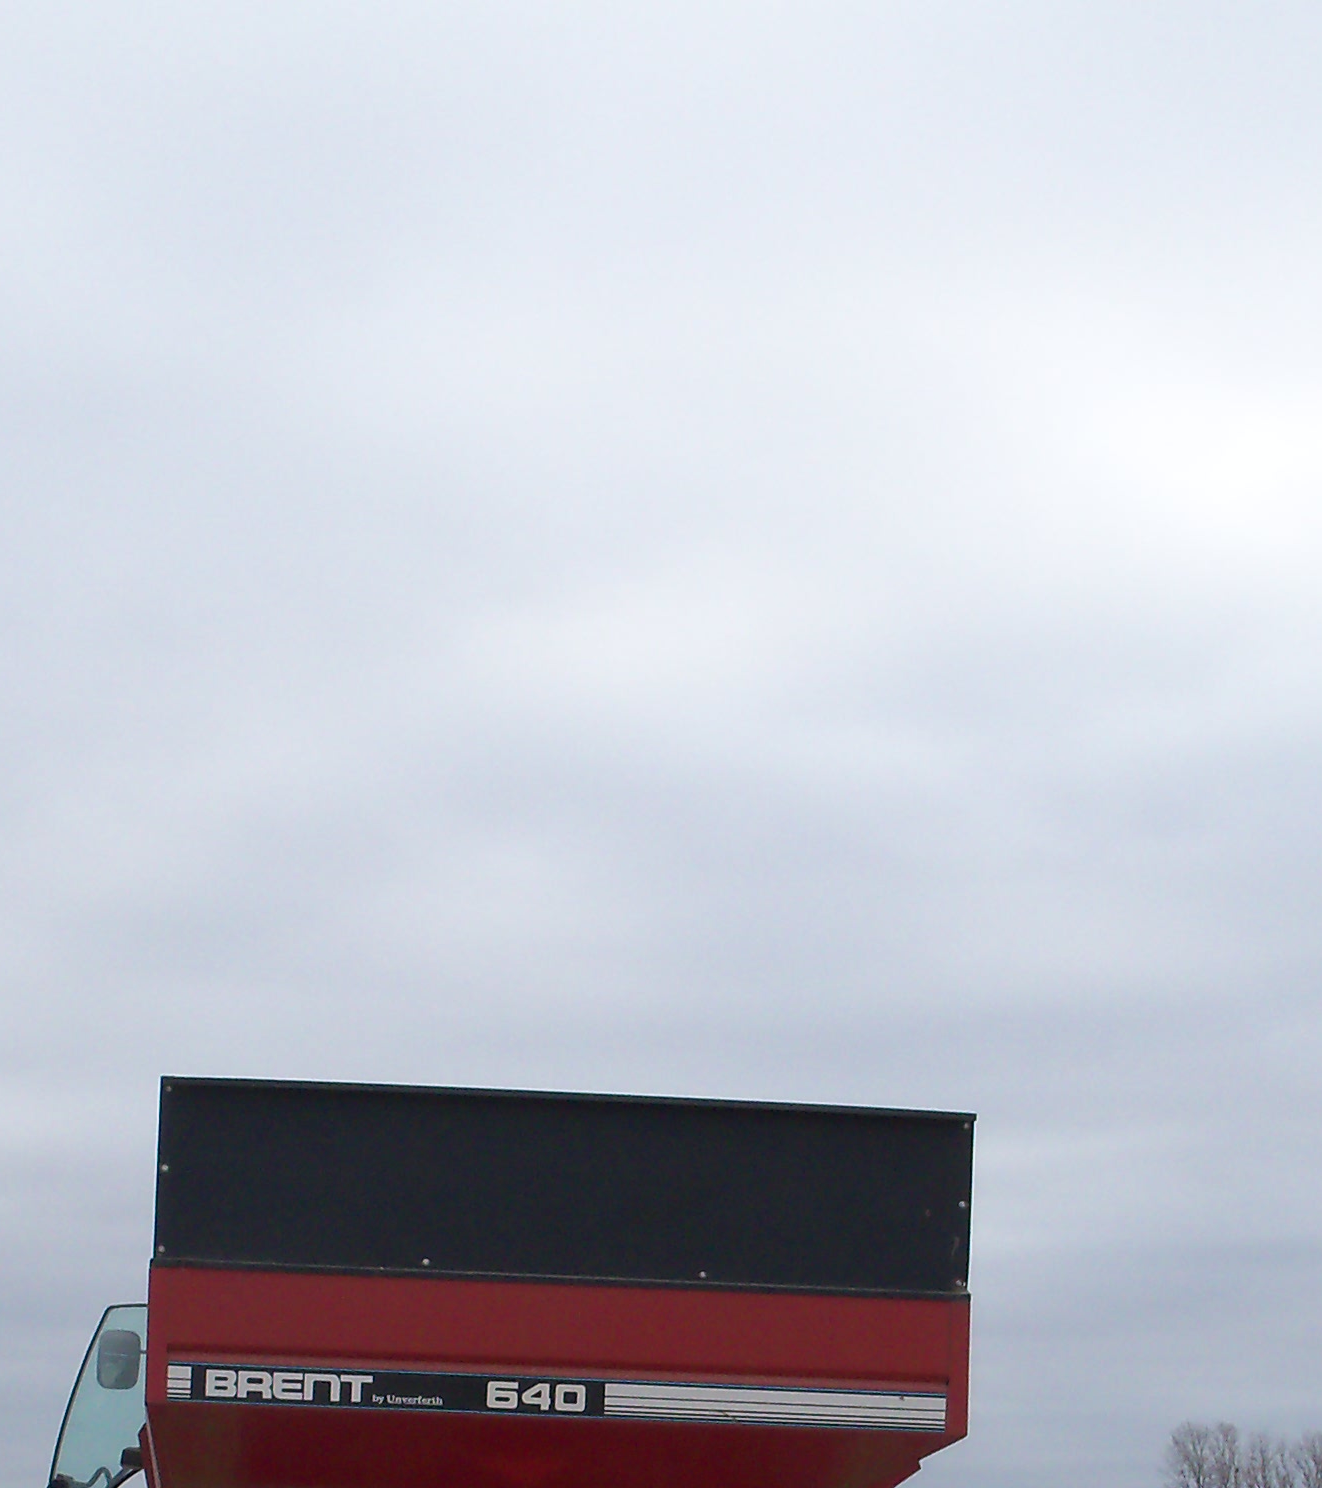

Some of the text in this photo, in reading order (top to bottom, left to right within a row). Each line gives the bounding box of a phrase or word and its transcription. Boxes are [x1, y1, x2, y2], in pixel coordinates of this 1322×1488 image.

[205, 1369, 374, 1403] BRENT
[372, 1394, 384, 1404] by
[486, 1380, 586, 1412] 640
